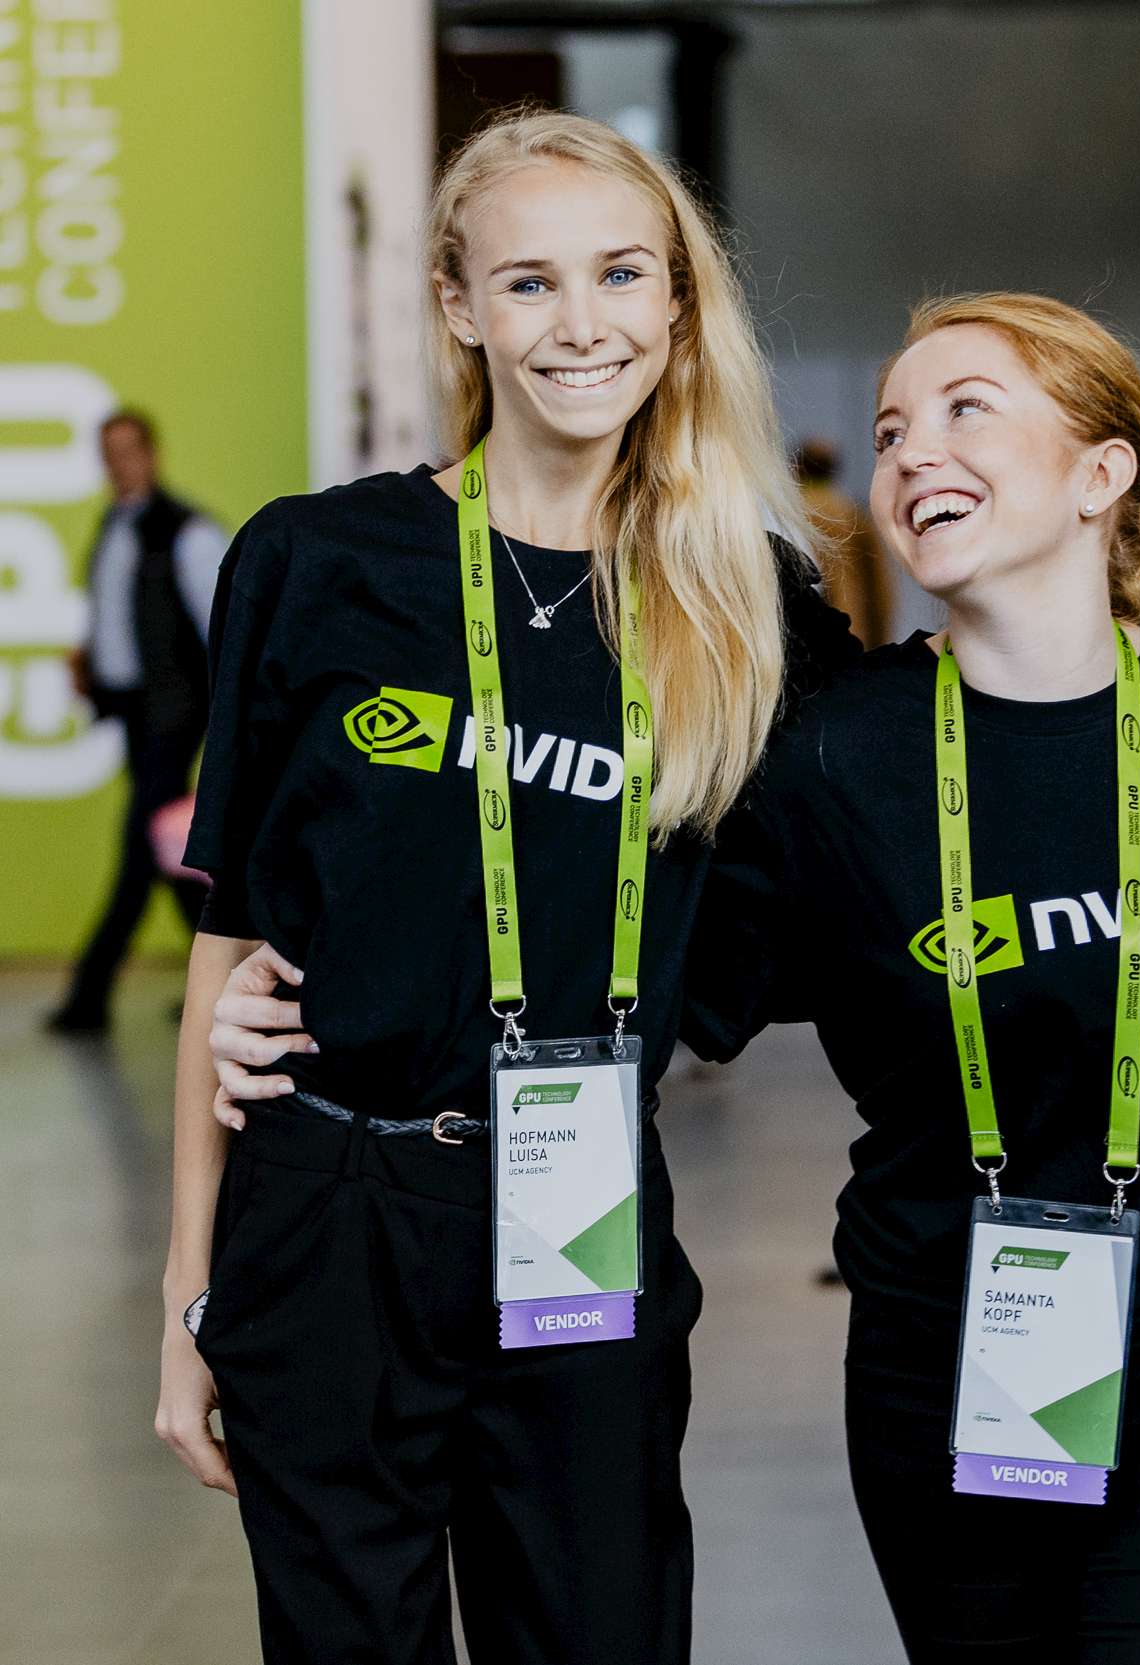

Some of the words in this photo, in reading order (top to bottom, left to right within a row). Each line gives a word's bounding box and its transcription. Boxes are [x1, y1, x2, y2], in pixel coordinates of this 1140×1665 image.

[471, 563, 483, 587] GPU
[484, 726, 496, 752] GPU
[944, 719, 956, 743] GPU
[631, 776, 642, 803] GPU
[1128, 785, 1139, 810] GPU
[952, 887, 964, 912] GPU
[496, 908, 508, 934] GPU
[1129, 953, 1140, 980] GPU
[968, 1063, 982, 1089] GPU
[518, 1092, 541, 1103] GPU
[509, 1129, 576, 1145] HOFMANN
[509, 1148, 548, 1162] LUISA
[508, 1167, 524, 1176] UCM
[525, 1166, 553, 1175] AGENCY
[999, 1252, 1024, 1265] GPU
[984, 1289, 1055, 1309] SAMANTA
[534, 1310, 604, 1332] VENDOR
[983, 1307, 1023, 1322] KOPF
[981, 1325, 999, 1335] UCM
[1000, 1327, 1031, 1337] AGENCY
[991, 1464, 1069, 1488] VENDOR
